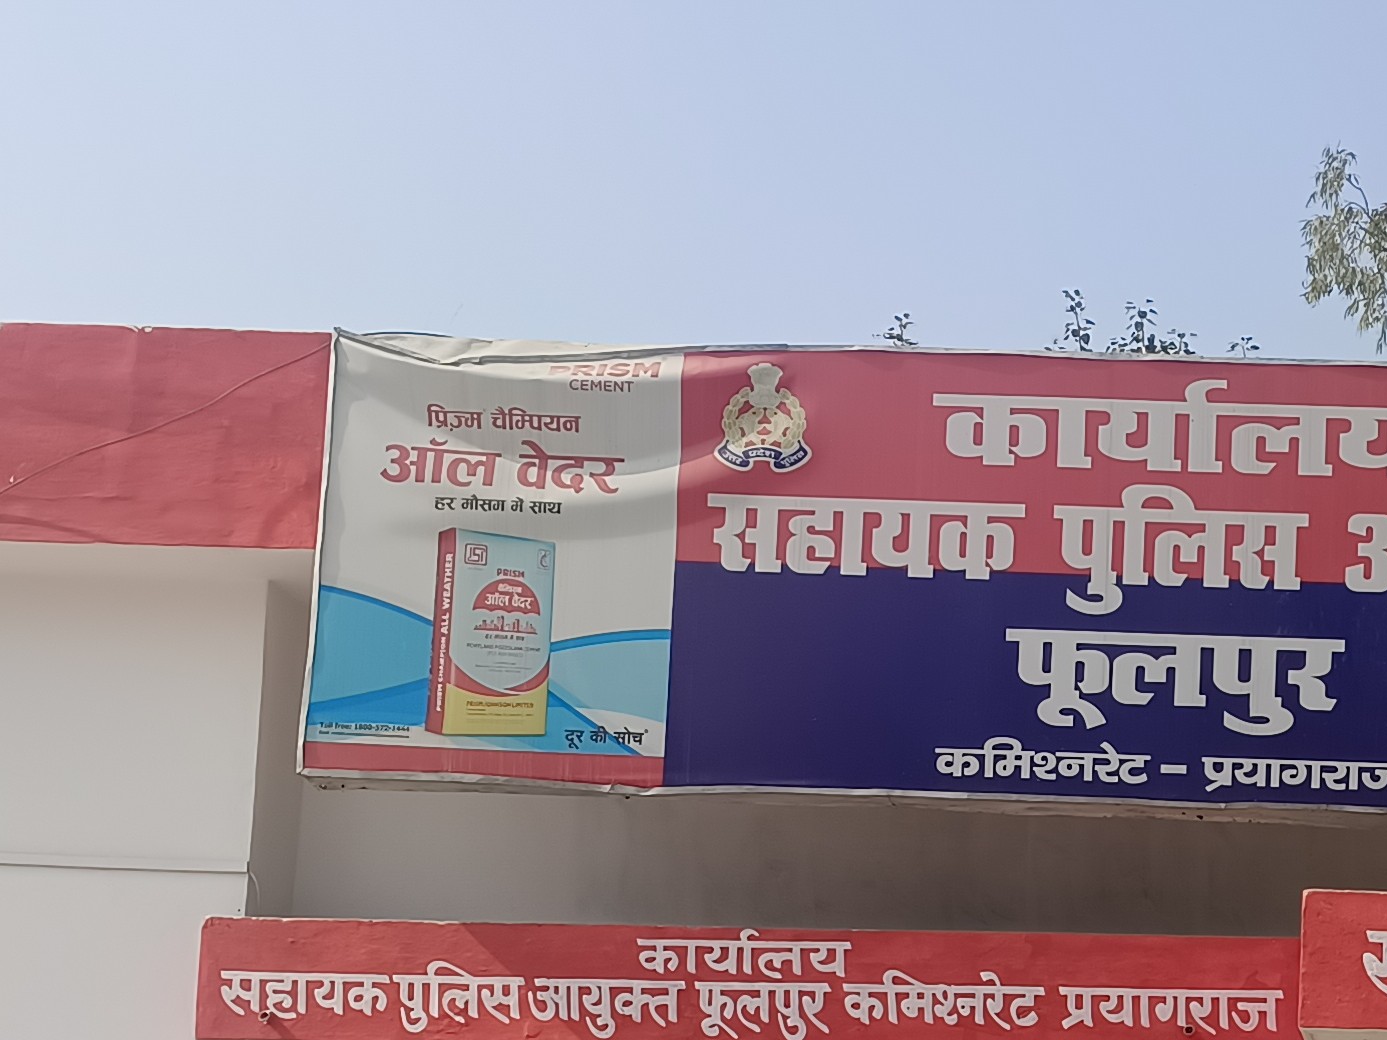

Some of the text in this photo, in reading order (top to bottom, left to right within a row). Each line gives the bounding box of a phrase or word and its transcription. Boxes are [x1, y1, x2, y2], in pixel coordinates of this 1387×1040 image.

[549, 361, 662, 378] PRISM
[569, 379, 635, 393] CEMENT
[490, 406, 581, 433] चैम्पियन
[380, 437, 625, 494] ऑल वेदर
[434, 496, 457, 511] हर
[529, 500, 563, 515] साथ
[707, 493, 1026, 580] सहायक
[1054, 484, 1310, 616] पुलिस
[1006, 627, 1346, 736] फूलपुर
[563, 725, 645, 750] दूर की सोच
[934, 736, 1151, 784] कमिश्नरेट
[636, 928, 852, 979] कार्यालय
[220, 970, 391, 1019] सहायक
[392, 960, 526, 1034] पुलिस
[527, 977, 686, 1039] आयुक्त
[842, 969, 1046, 1031] कमिश्नरेट
[1058, 986, 1284, 1035] प्रयागराज
